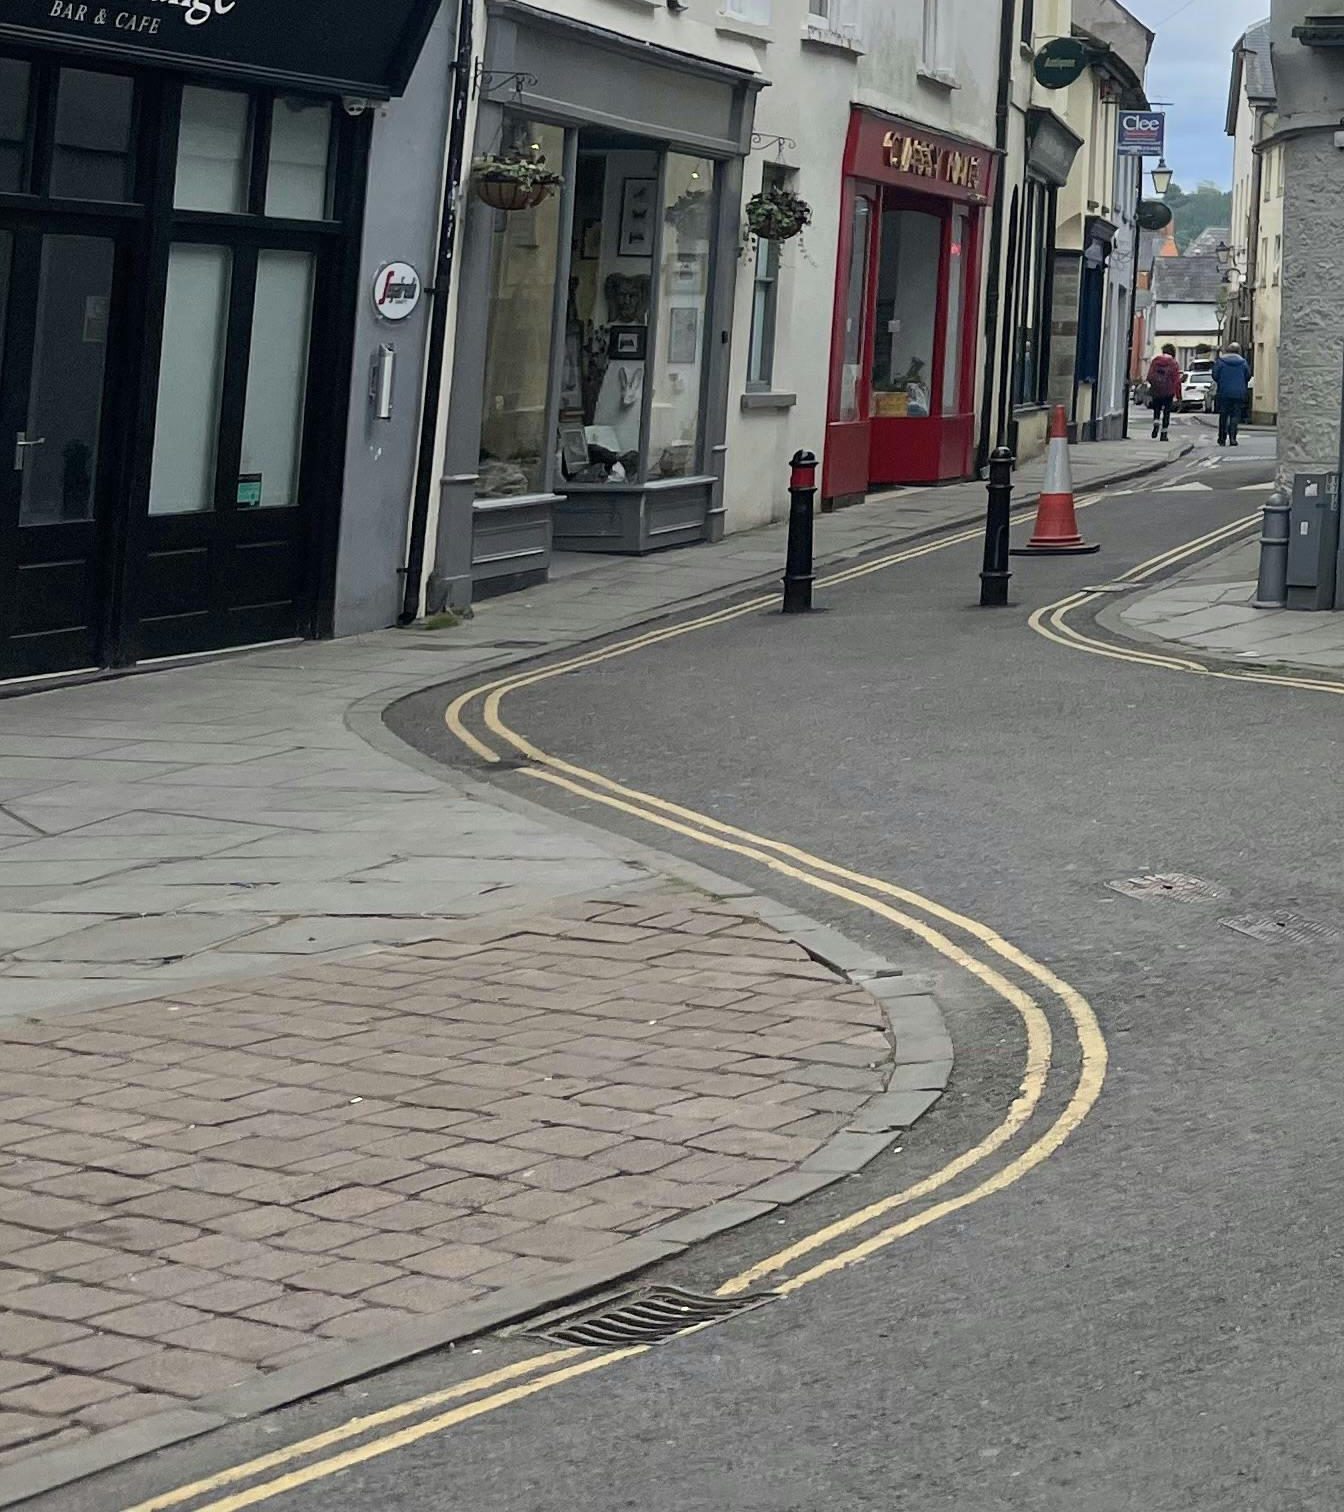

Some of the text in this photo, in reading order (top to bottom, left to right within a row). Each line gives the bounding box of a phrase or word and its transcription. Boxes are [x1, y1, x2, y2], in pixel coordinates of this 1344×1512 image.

[49, 0, 162, 34] BAR & CAFE
[1122, 115, 1160, 131] Clee
